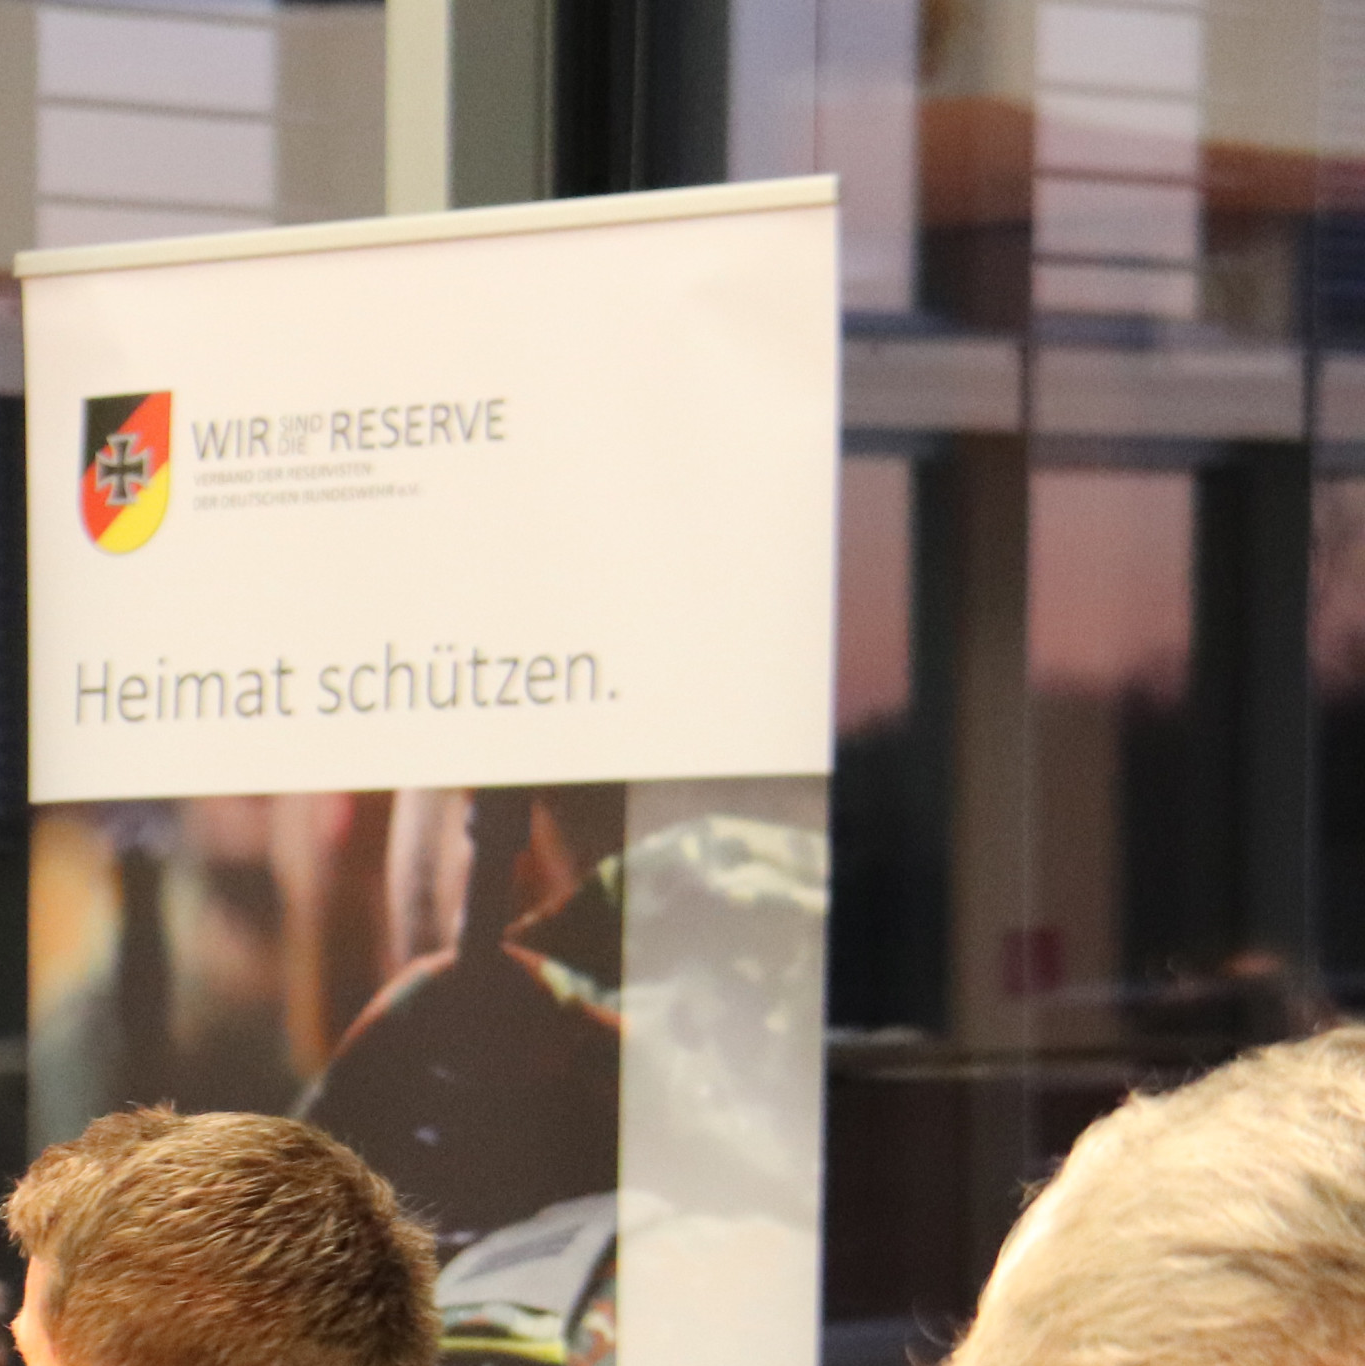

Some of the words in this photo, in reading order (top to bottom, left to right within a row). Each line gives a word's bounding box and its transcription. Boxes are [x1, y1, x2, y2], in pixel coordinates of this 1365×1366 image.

[279, 413, 323, 435] SIND
[329, 399, 507, 452] RESERVE
[191, 416, 271, 461] WIR
[277, 434, 308, 456] DIE
[193, 470, 254, 487] VERBAND
[257, 466, 284, 483] DER
[193, 493, 218, 511] DER
[75, 656, 295, 727] Heimat
[317, 642, 620, 715] schützen.
